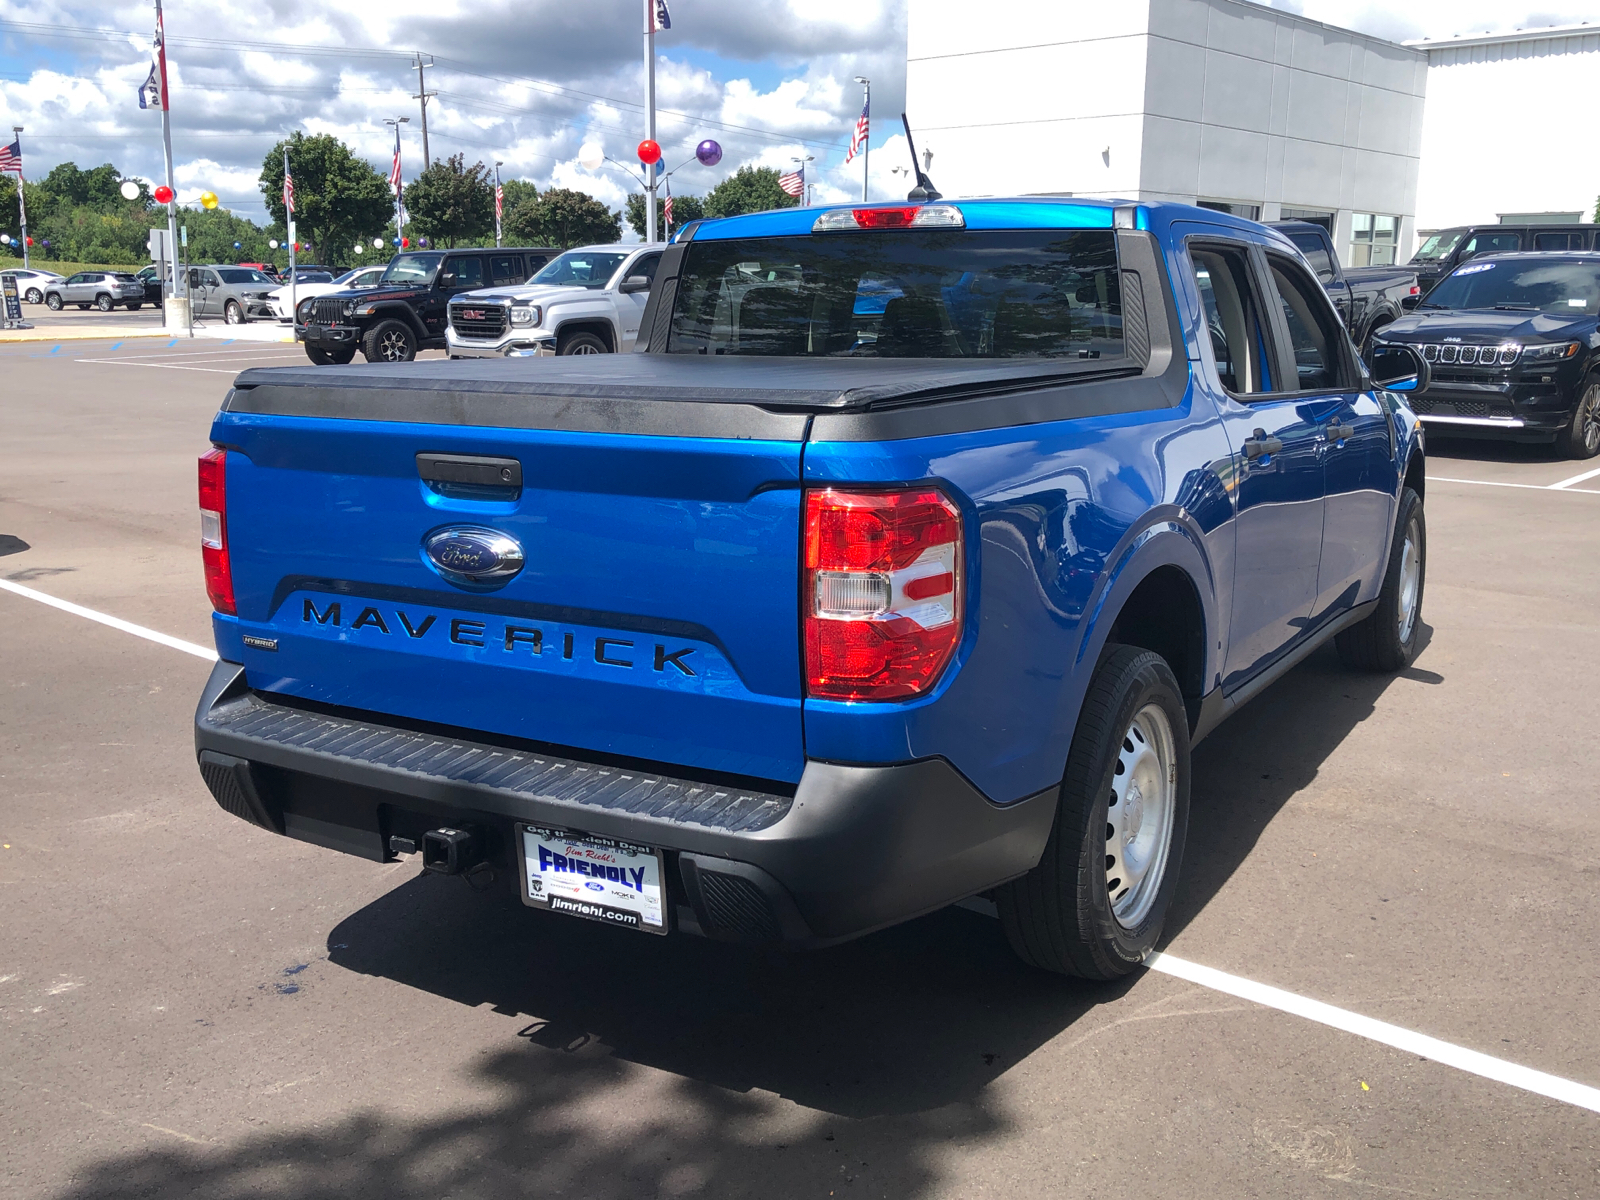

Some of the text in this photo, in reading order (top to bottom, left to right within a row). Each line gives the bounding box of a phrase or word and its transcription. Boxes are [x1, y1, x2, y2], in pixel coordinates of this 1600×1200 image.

[462, 309, 486, 320] GMC
[1443, 335, 1462, 343] Jeep
[441, 542, 482, 568] Ford
[244, 636, 275, 648] HYBRID
[302, 598, 698, 677] MAVERICK
[527, 825, 551, 836] Get
[619, 841, 651, 854] Deal
[565, 845, 616, 863] Jim Riehl's
[538, 843, 646, 893] FRIENDLY
[551, 898, 637, 924] jimriehl.com
